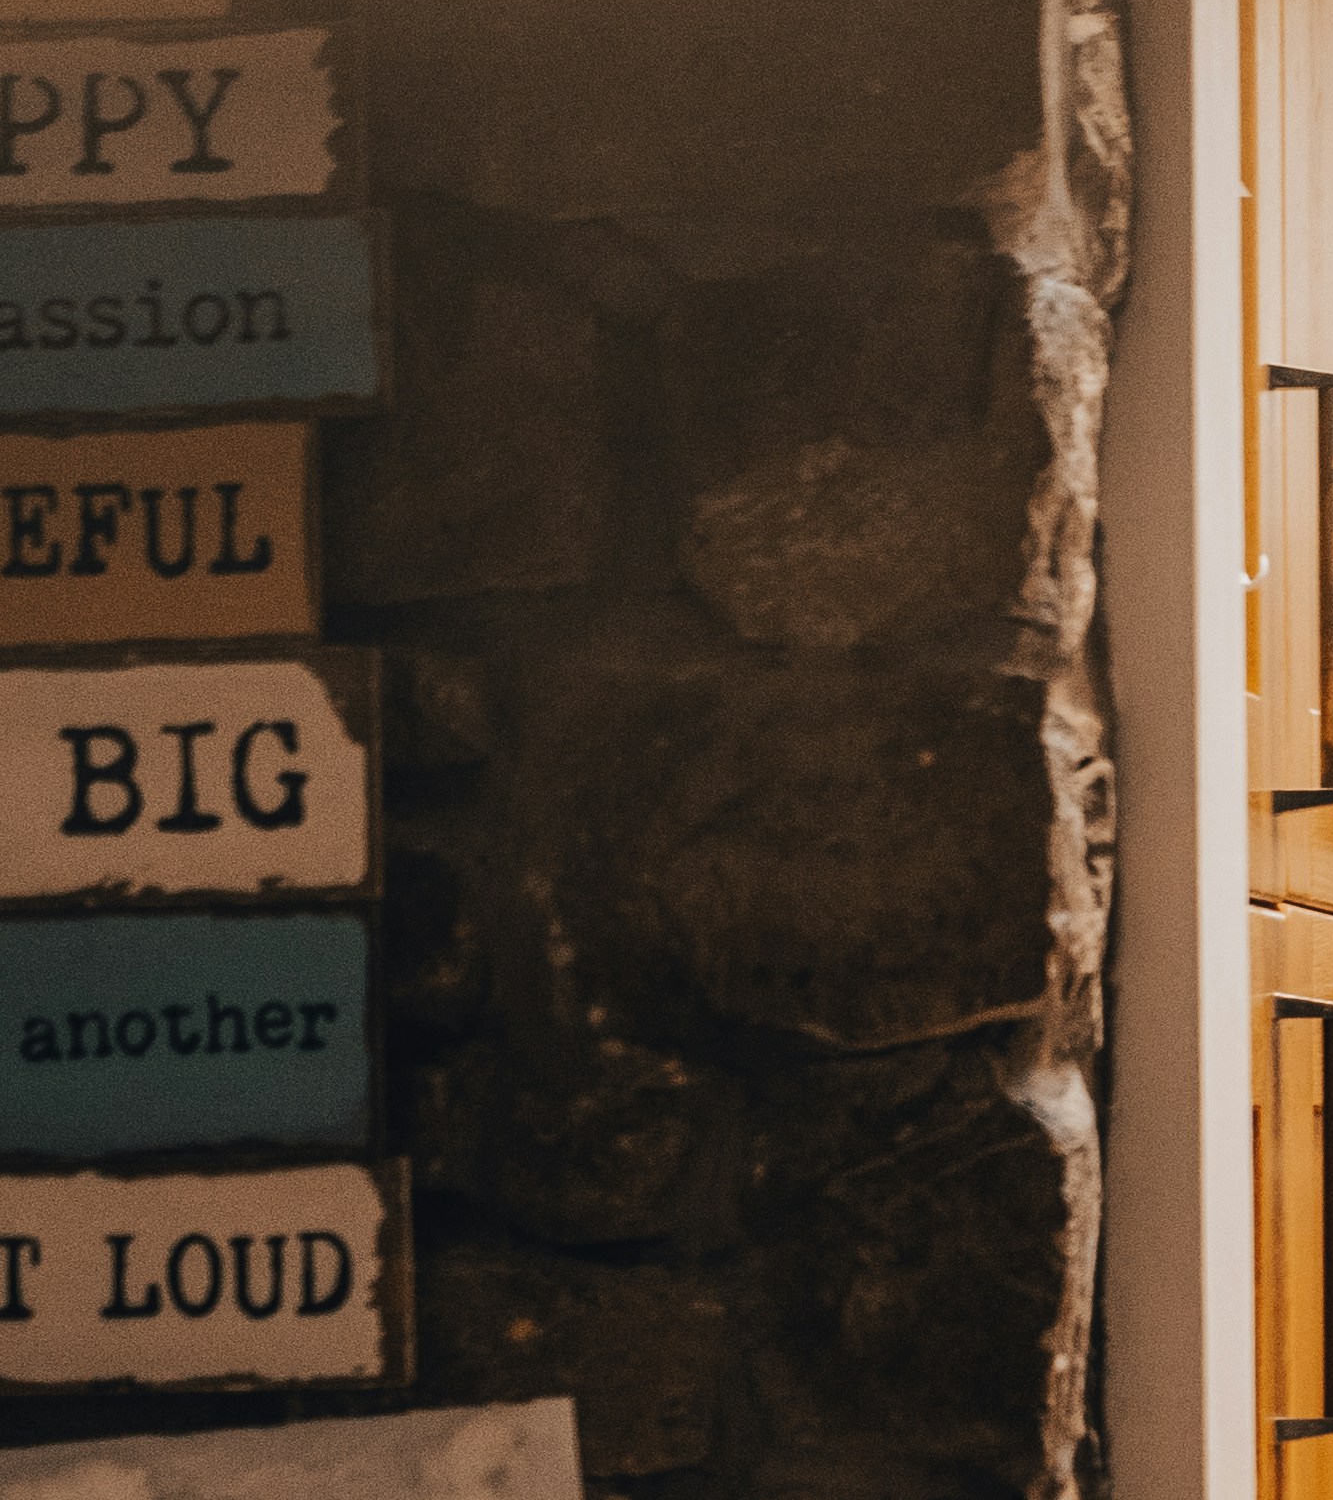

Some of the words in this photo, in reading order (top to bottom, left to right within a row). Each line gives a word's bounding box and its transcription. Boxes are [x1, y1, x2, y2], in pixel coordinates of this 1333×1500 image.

[0, 67, 242, 176] PPY
[0, 278, 292, 352] assion
[2, 482, 273, 579] EFUL
[58, 719, 310, 836] BIG
[19, 992, 338, 1064] another
[99, 1231, 354, 1320] LOUD
